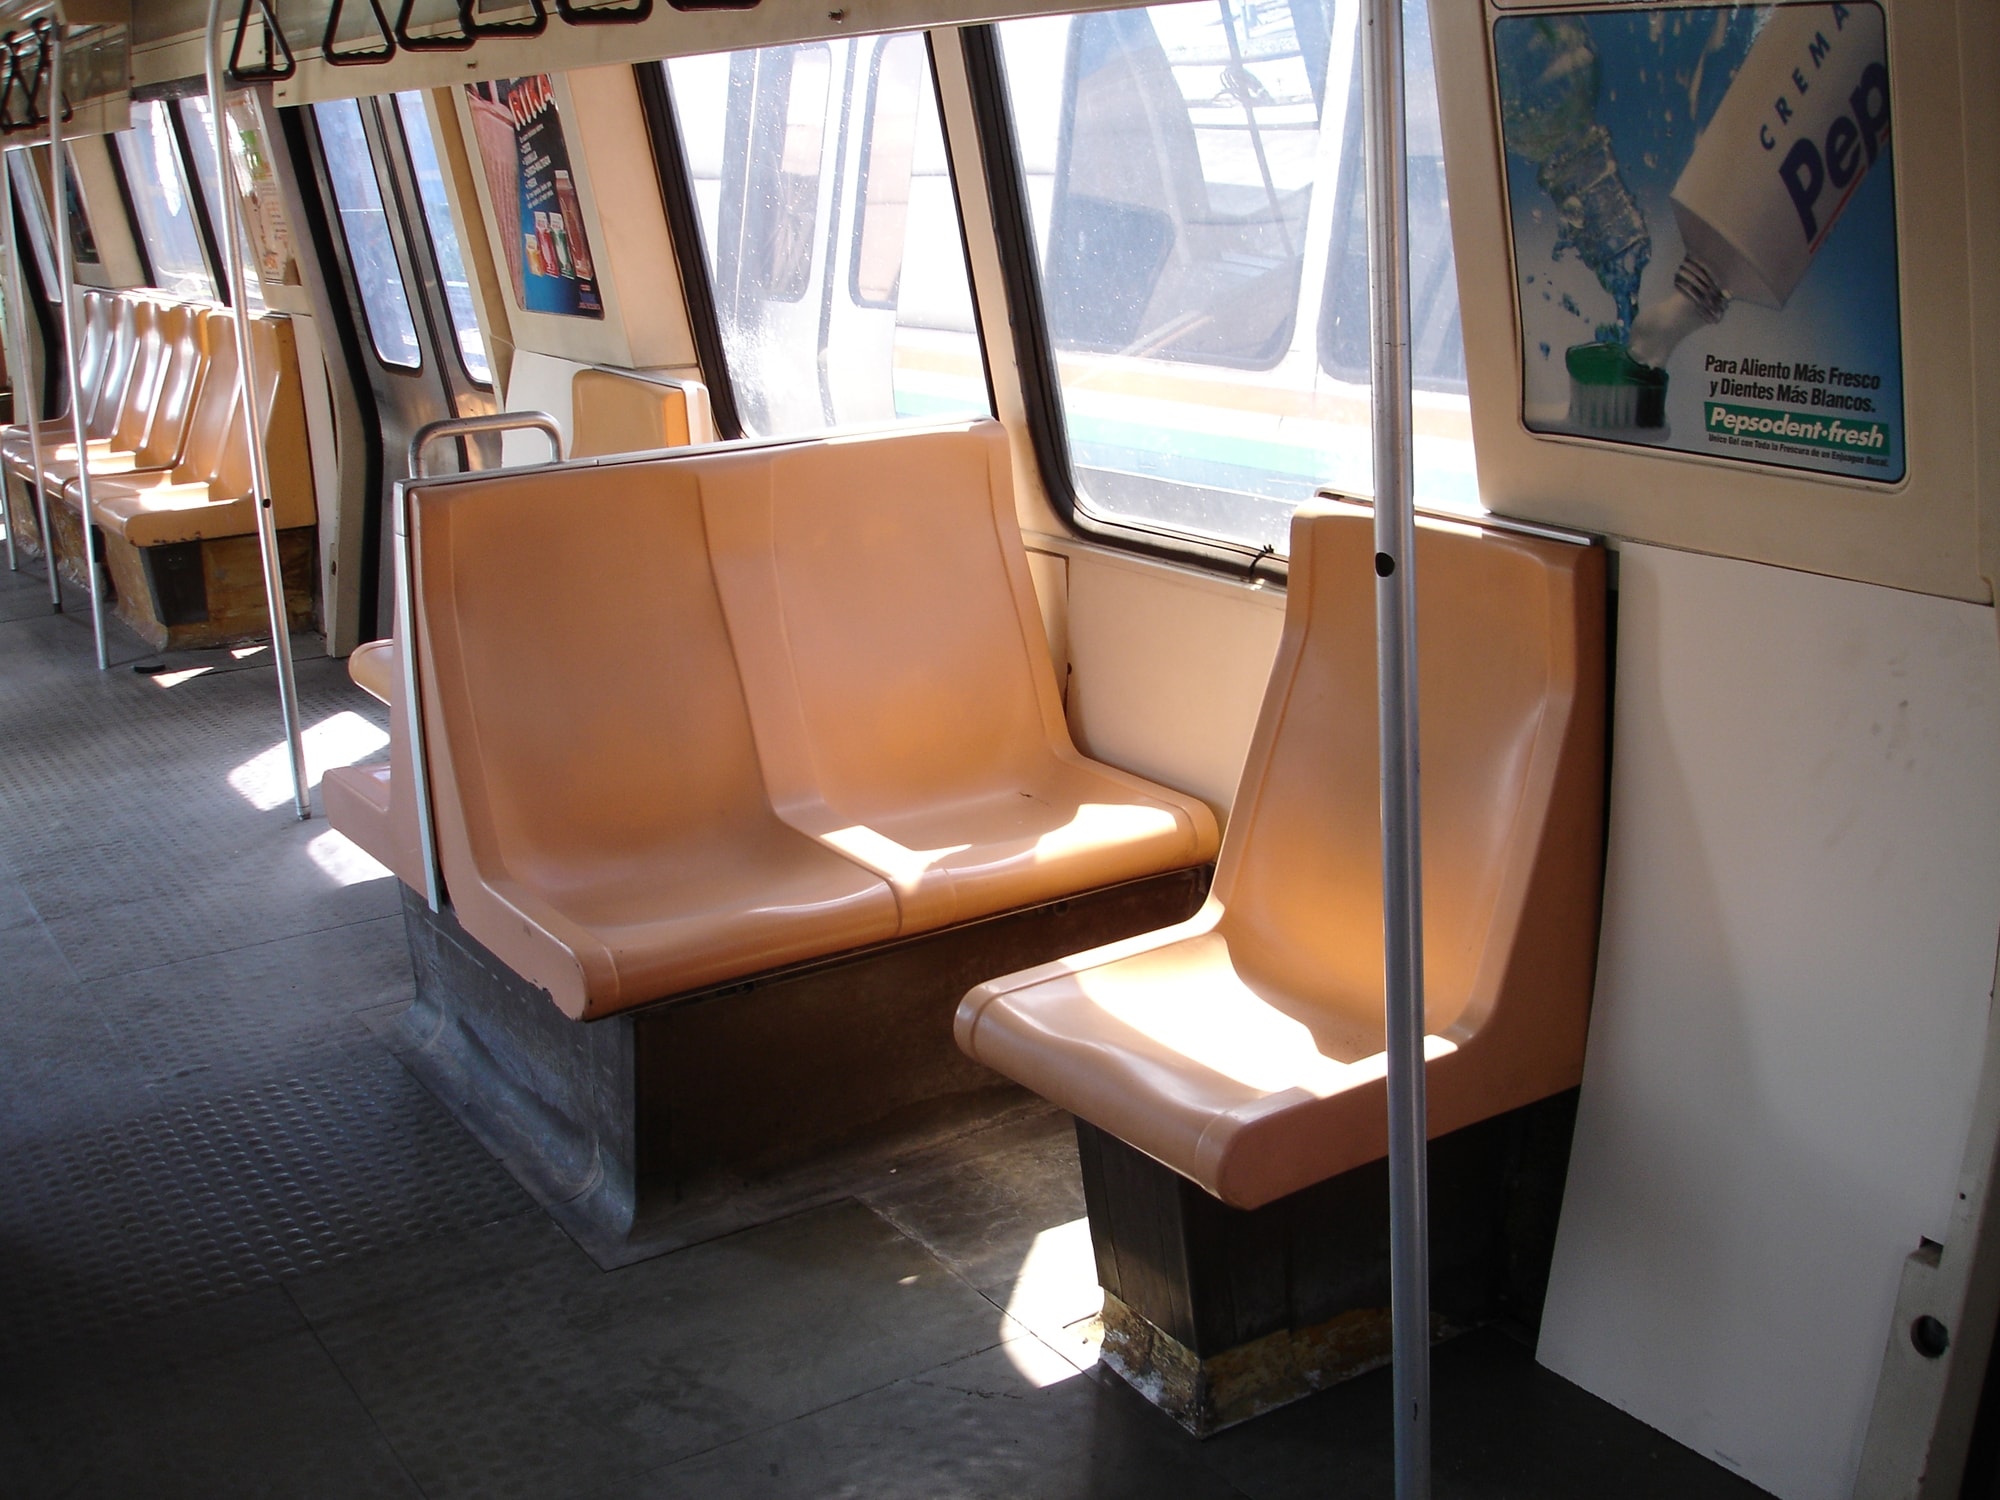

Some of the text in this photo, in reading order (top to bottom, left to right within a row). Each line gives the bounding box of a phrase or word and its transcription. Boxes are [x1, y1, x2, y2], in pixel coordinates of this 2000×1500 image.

[1760, 3, 1850, 150] CREMA
[1705, 354, 1881, 390] Para Aliento Más Fresco
[1709, 378, 1877, 413] y Dientes Más Blancos.
[1728, 436, 1740, 446] Gel
[1741, 440, 1753, 448] con
[1780, 444, 1810, 456] Frescura
[1811, 447, 1820, 457] de
